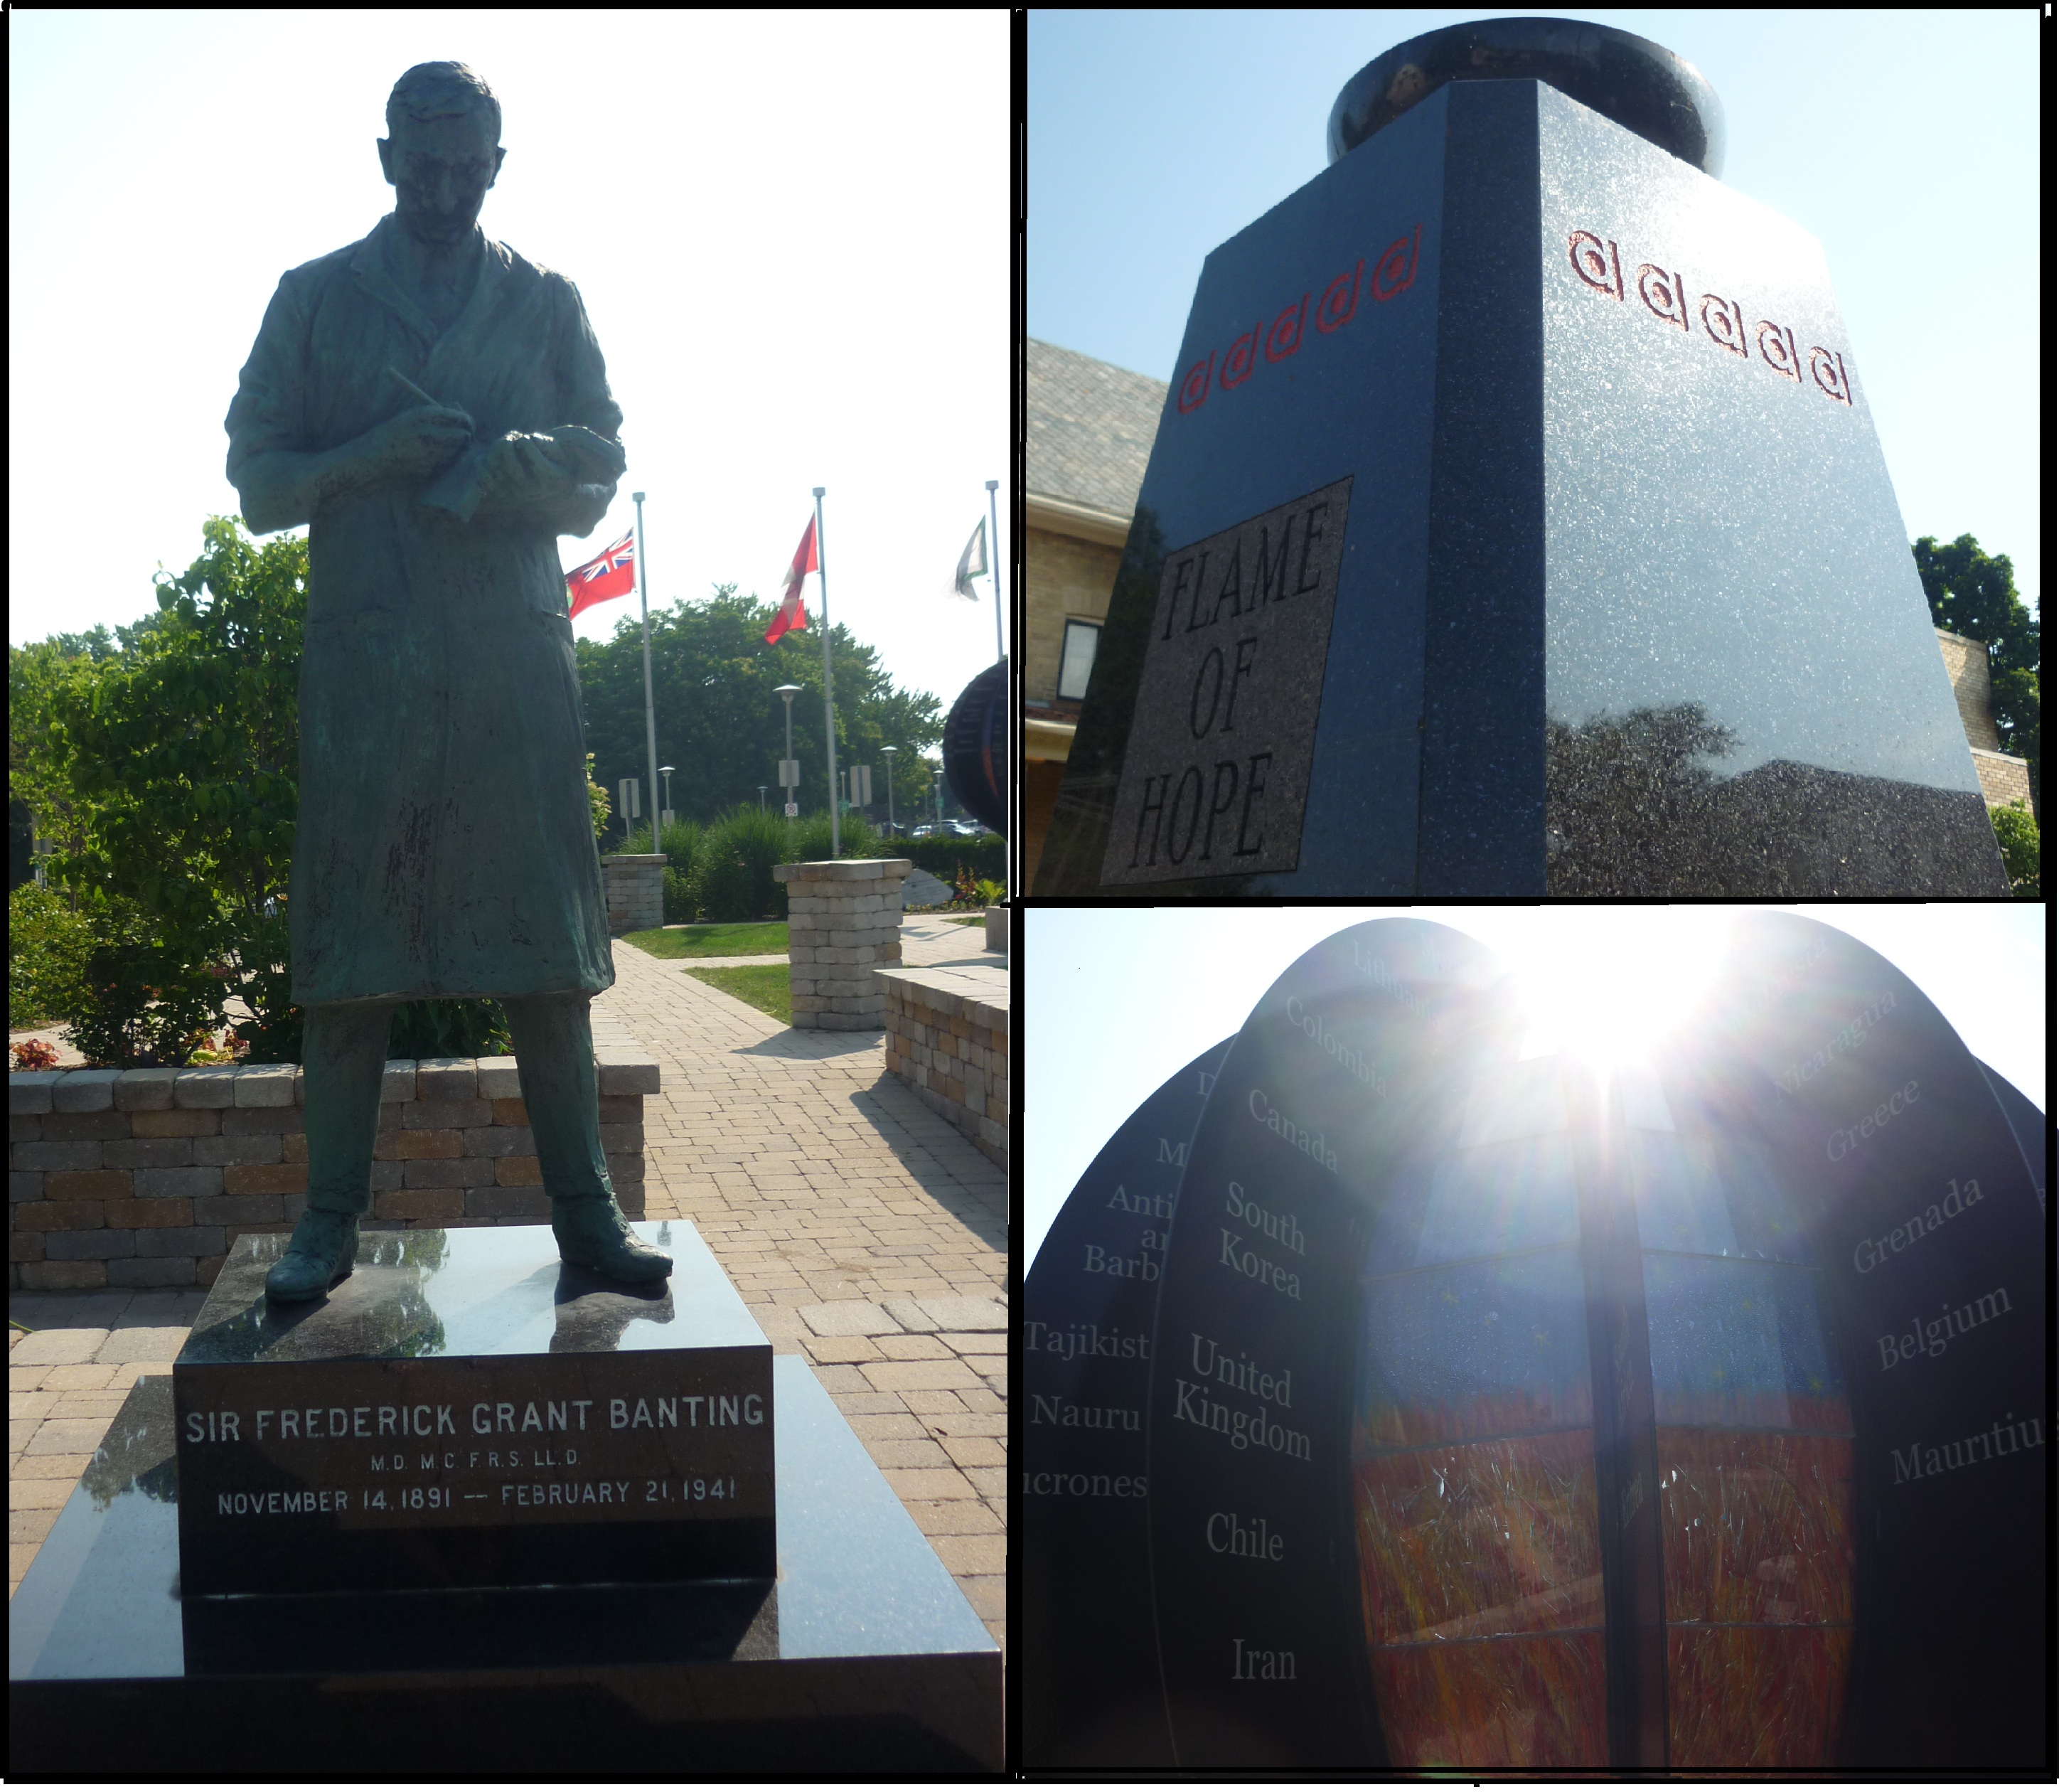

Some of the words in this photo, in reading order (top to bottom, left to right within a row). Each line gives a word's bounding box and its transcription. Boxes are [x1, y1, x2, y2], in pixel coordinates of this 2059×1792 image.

[1160, 501, 1328, 640] FLAME
[1189, 638, 1257, 740] OF
[1128, 752, 1273, 869] HOPE
[1286, 996, 1387, 1098] Colombia
[1773, 991, 1899, 1106] Nicaragua
[1248, 1089, 1339, 1174] Canada
[1827, 1079, 1920, 1163] Greece
[1226, 1181, 1305, 1255] South
[1854, 1178, 1985, 1274] Grenada
[1219, 1227, 1302, 1301] Korea
[1876, 1286, 2013, 1371] Belgium
[1031, 1394, 1141, 1431] Nauru
[1192, 1333, 1293, 1409] United
[186, 1412, 240, 1443] SIR
[257, 1404, 456, 1441] FREDERICK
[472, 1399, 594, 1434] GRANT
[610, 1394, 765, 1429] BANTING
[1174, 1378, 1312, 1461] Kingdom
[1890, 1413, 2046, 1486] Mauritiu
[218, 1489, 349, 1515] NOVEMBER
[502, 1481, 630, 1505] FEBRUARY
[1207, 1513, 1284, 1562] Chile
[1232, 1638, 1298, 1680] Iran
